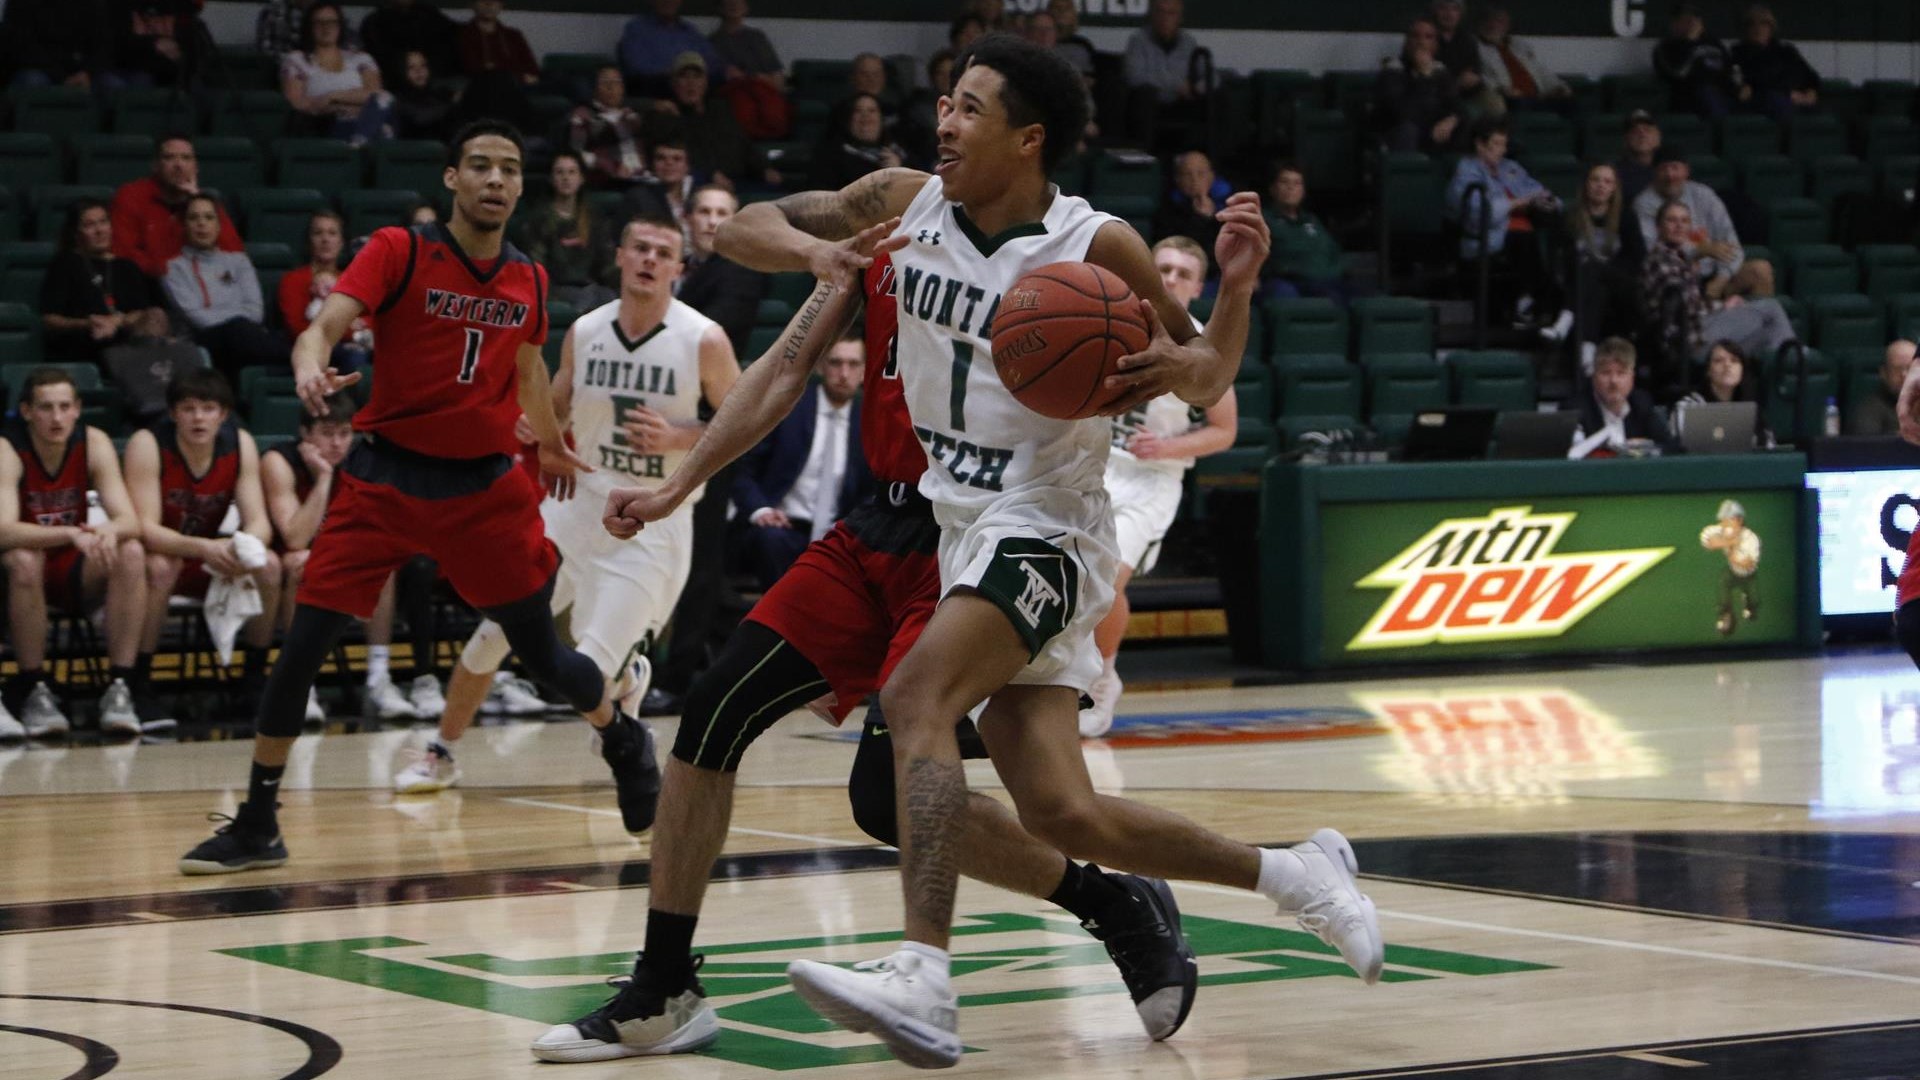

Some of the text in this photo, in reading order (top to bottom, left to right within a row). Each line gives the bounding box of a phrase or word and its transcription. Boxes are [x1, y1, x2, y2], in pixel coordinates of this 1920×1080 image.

[425, 288, 529, 328] WESTERN
[904, 266, 1001, 340] MONTA
[457, 327, 484, 384] 1
[585, 358, 676, 396] MONTANA
[950, 338, 974, 433] 1
[599, 444, 665, 478] TECH
[1400, 518, 1552, 570] Mtn
